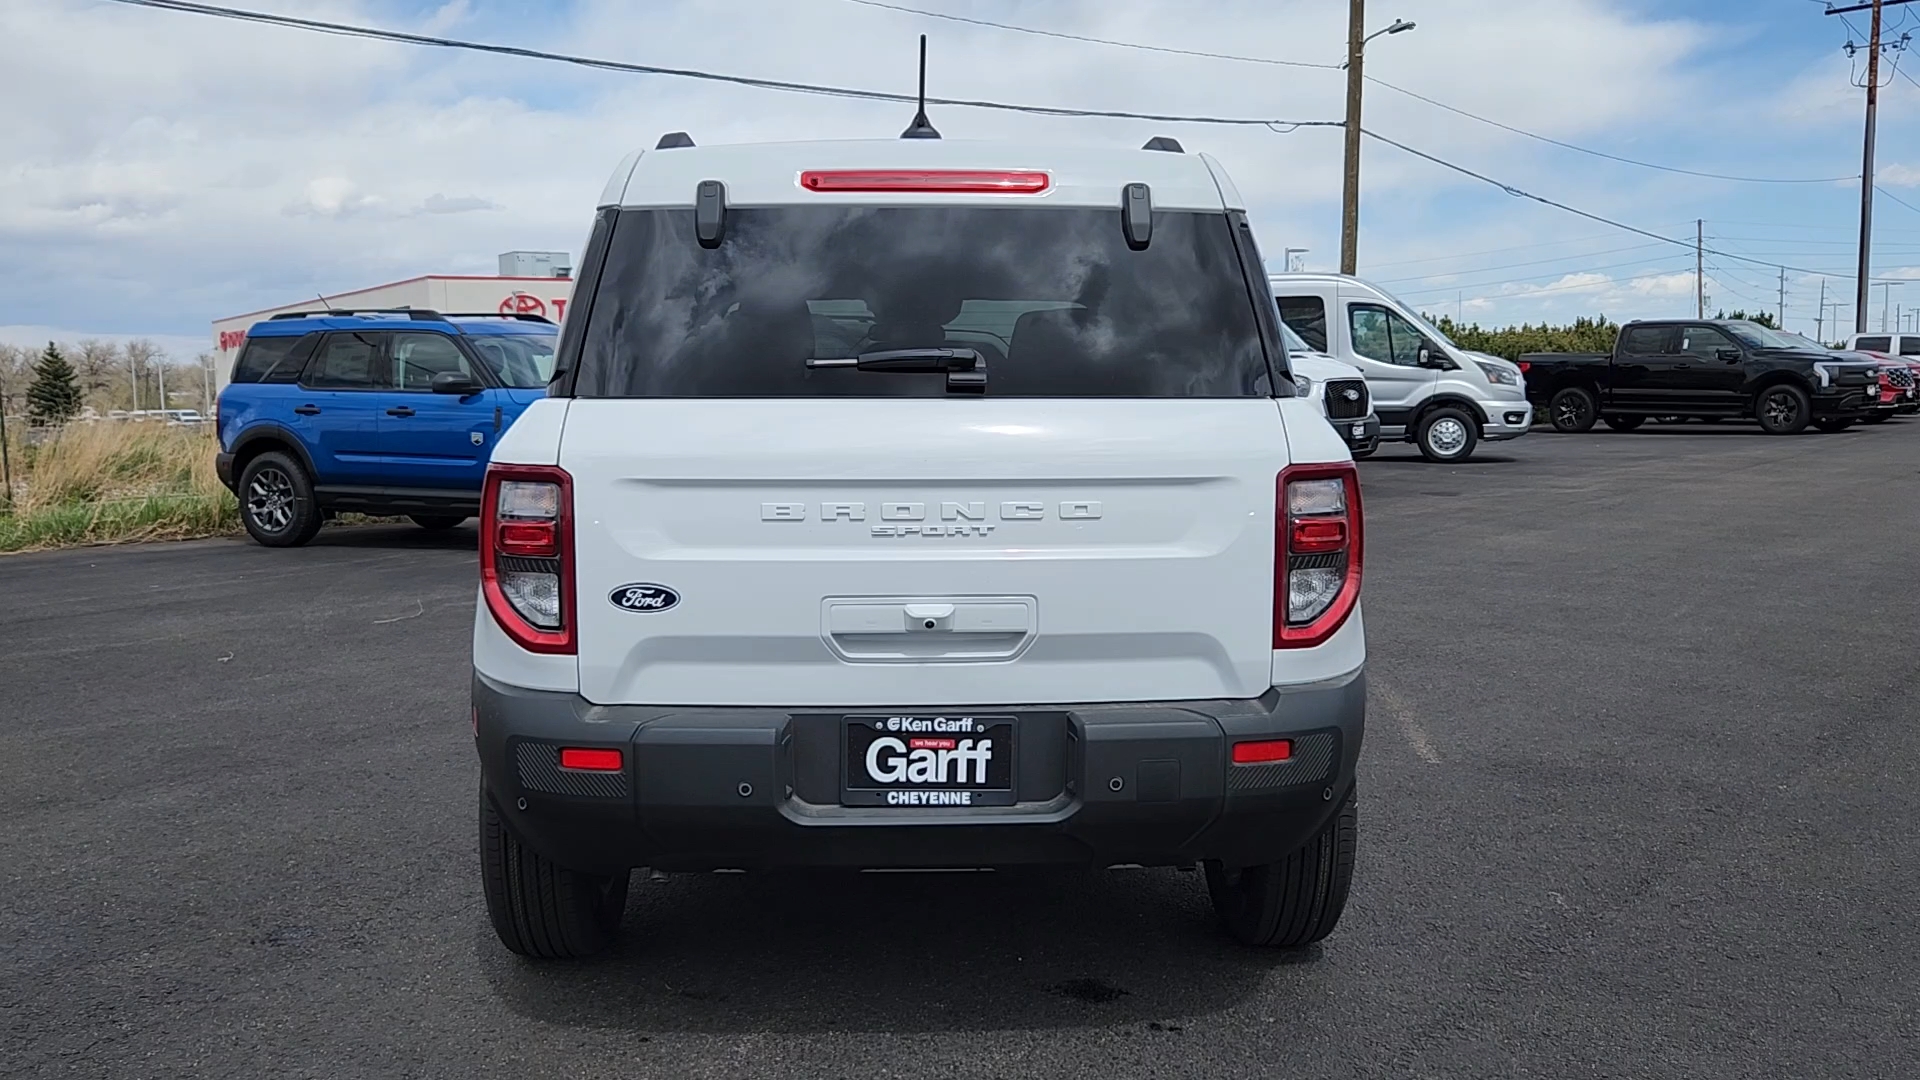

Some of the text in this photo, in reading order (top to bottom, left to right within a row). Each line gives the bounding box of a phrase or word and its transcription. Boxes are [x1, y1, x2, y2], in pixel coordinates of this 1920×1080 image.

[760, 501, 1103, 521] BRONCO
[871, 525, 995, 537] SPORT
[621, 588, 666, 607] Ford
[901, 717, 973, 732] Ken Garff
[938, 740, 950, 748] you
[865, 736, 992, 784] Garff
[887, 791, 972, 805] CHEYENNE
